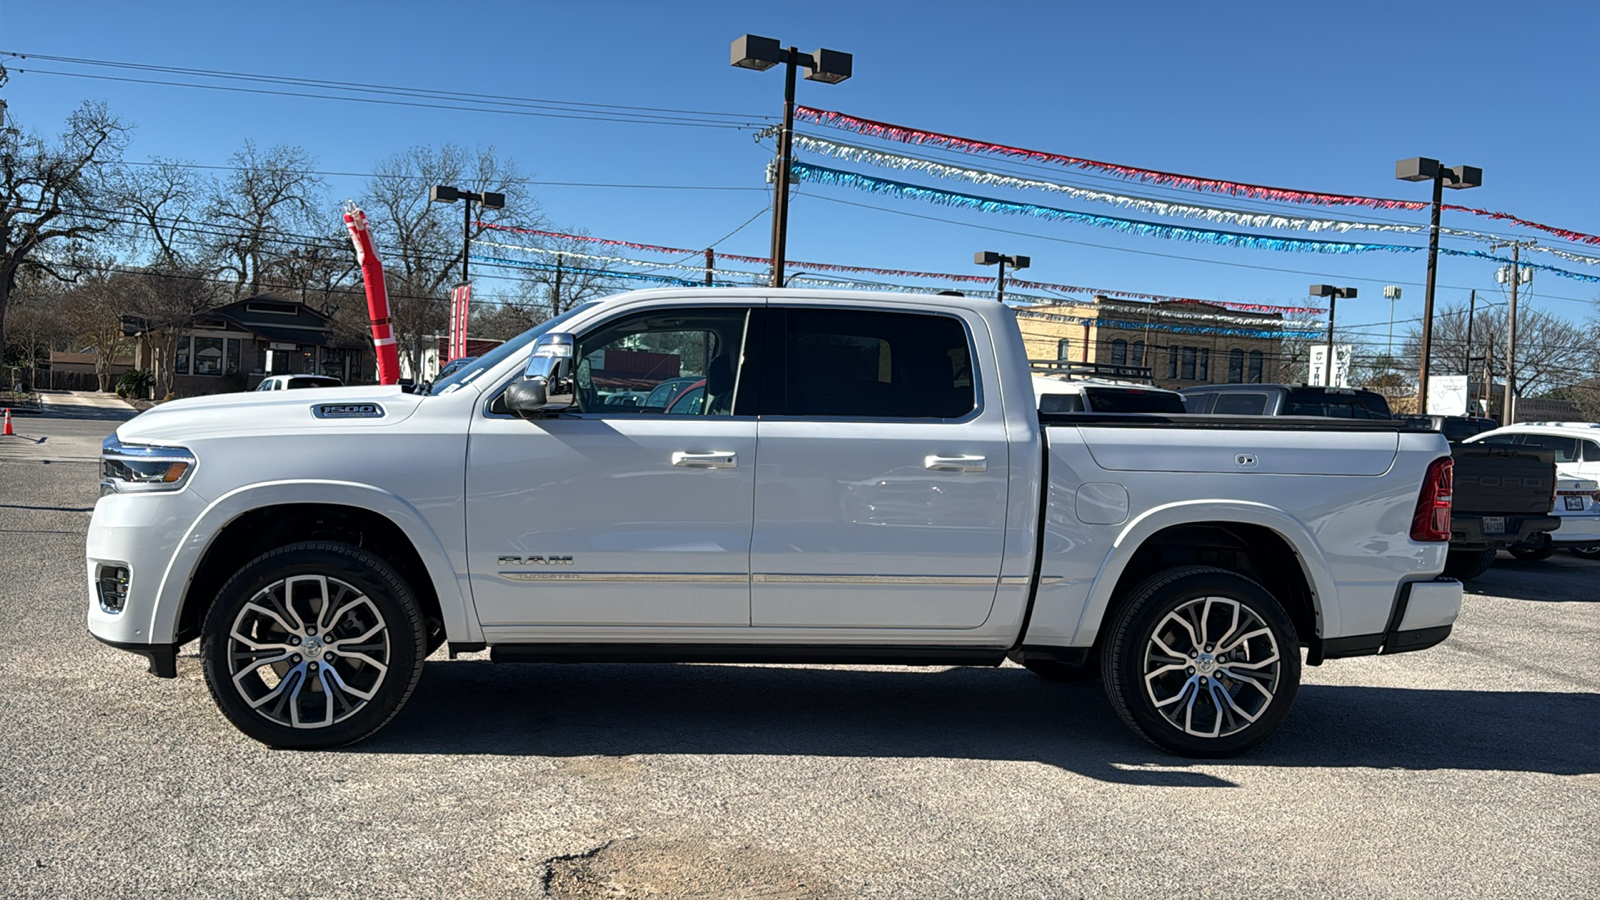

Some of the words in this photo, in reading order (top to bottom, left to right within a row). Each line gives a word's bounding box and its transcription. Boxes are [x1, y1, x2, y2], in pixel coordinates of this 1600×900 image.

[321, 405, 374, 413] 1500
[1455, 475, 1543, 488] FORD
[498, 556, 573, 565] RAM
